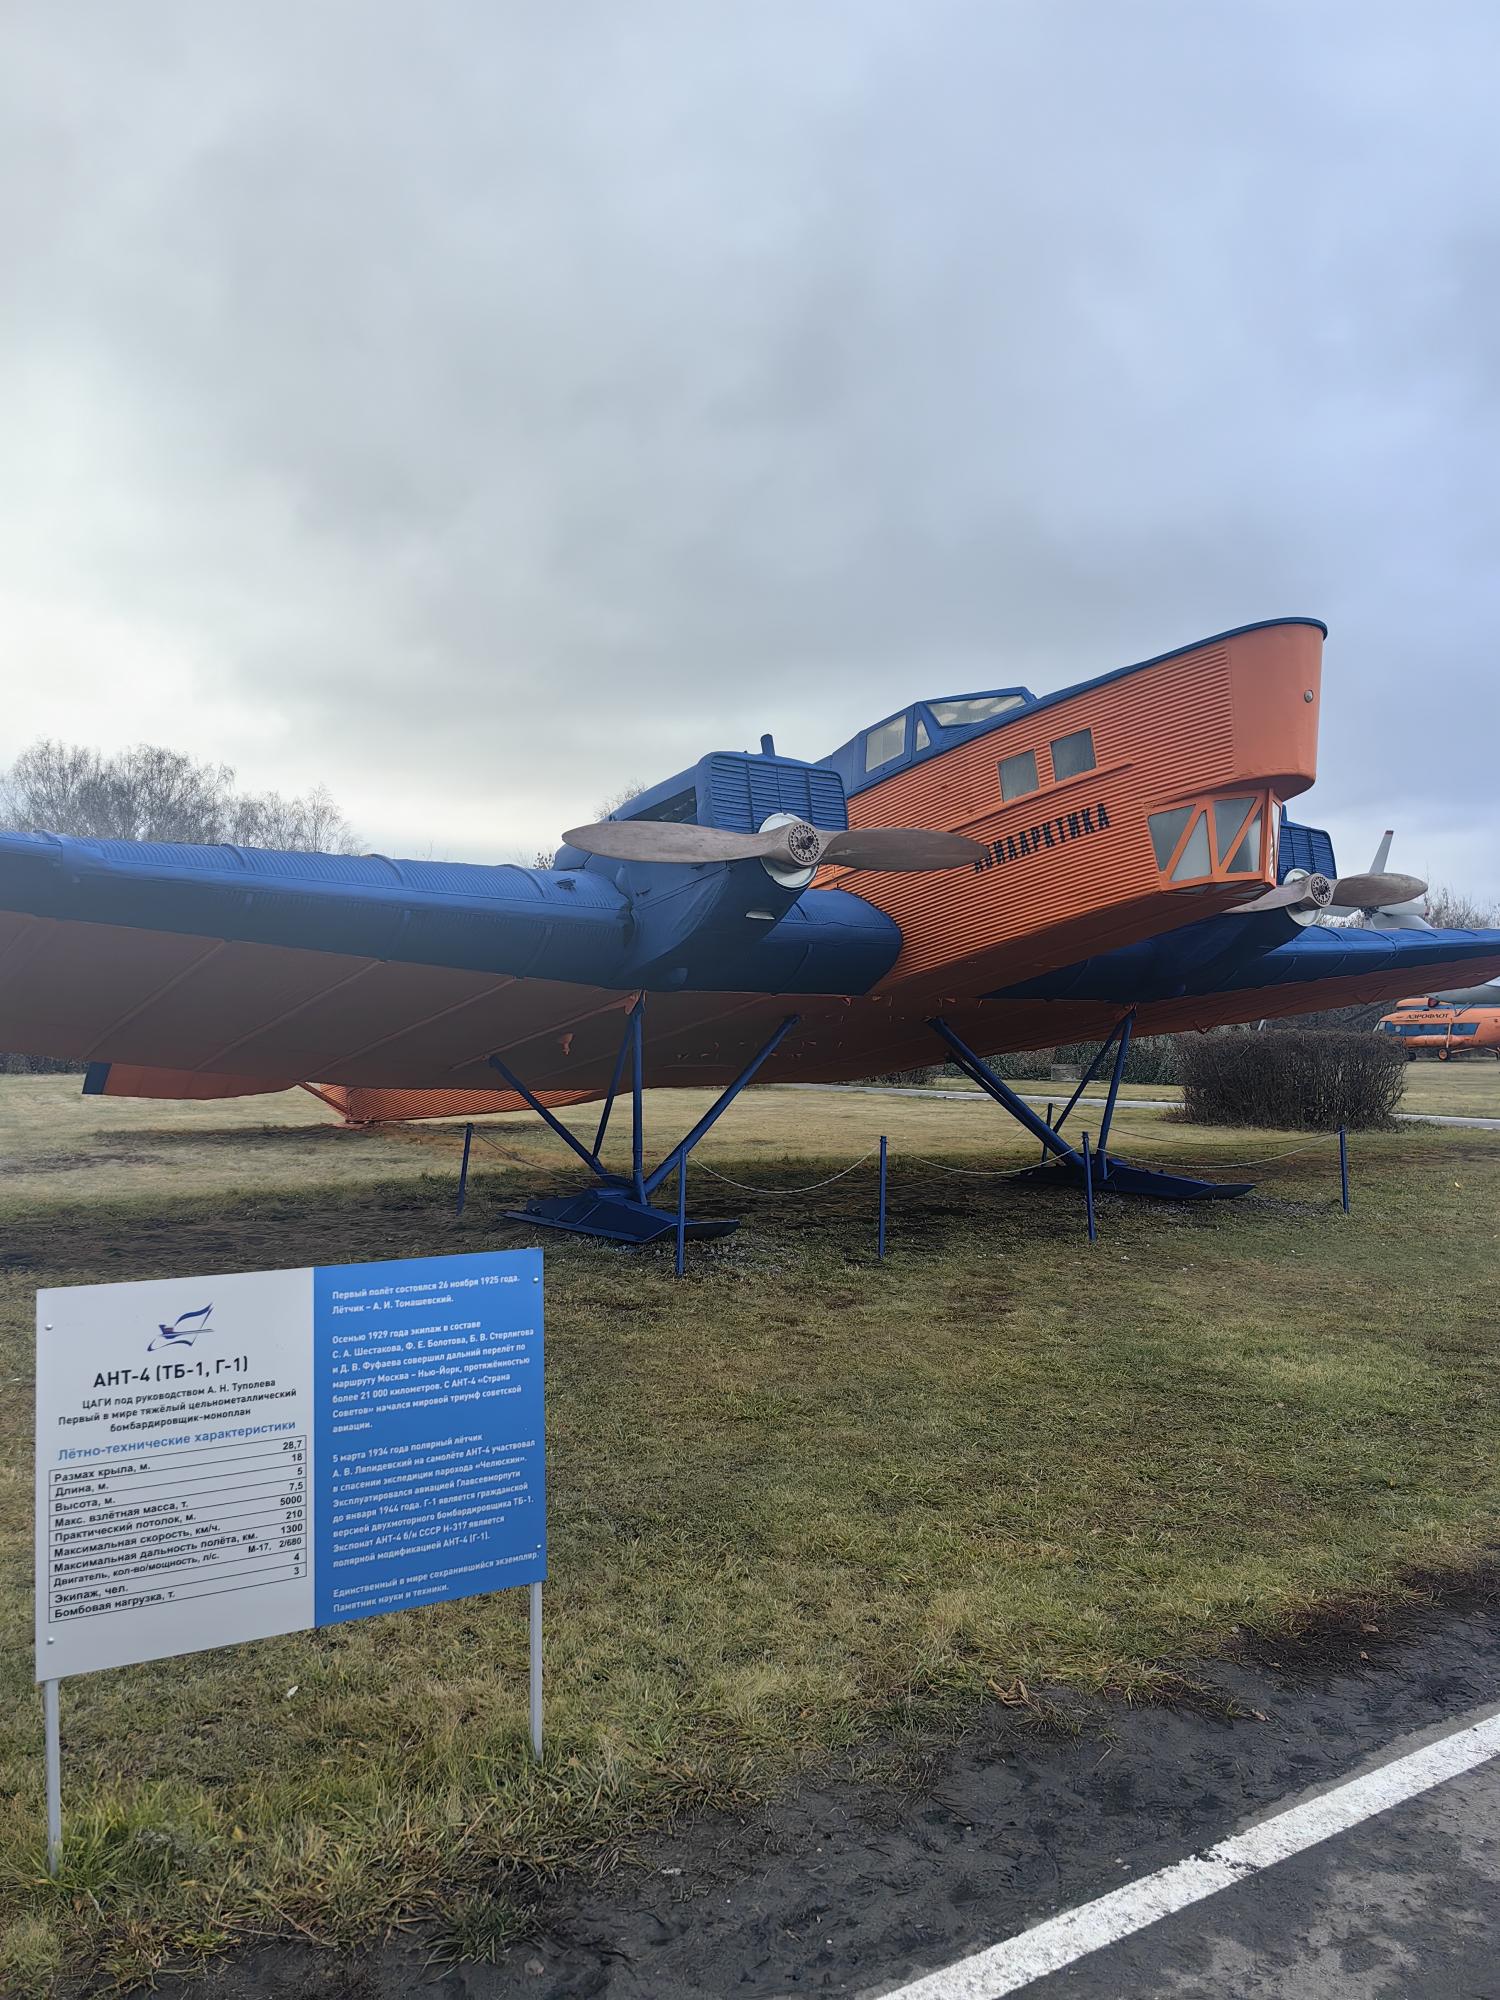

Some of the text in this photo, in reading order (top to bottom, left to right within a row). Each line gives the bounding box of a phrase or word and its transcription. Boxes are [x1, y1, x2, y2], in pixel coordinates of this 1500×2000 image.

[332, 1275, 520, 1300] Первый полёт состоялся 26 ноября 1925 года.
[332, 1305, 364, 1314] Лётчик
[373, 1302, 382, 1310] А.
[383, 1301, 393, 1309] И.
[395, 1294, 454, 1308] Томашевский.
[332, 1334, 366, 1344] Осенью
[368, 1330, 388, 1340] 1929
[389, 1329, 409, 1338] года
[410, 1326, 442, 1335] экипаж
[450, 1321, 481, 1331] составе
[332, 1329, 534, 1359] С. А. Шестакова, Ф. Е. Болотова, Б. В. Стерлигова
[93, 1355, 248, 1388] АНТ-4 (ТБ-1, Г-1)
[340, 1364, 350, 1374] Д.
[351, 1363, 360, 1371] В.
[362, 1359, 402, 1370] Фуфаева
[403, 1354, 445, 1365] совершил
[446, 1348, 481, 1360] дальний
[482, 1344, 515, 1356] перелёт
[332, 1377, 376, 1389] маршруту
[377, 1373, 409, 1383] Москва
[418, 1365, 462, 1378] Нью-Йорк,
[464, 1357, 530, 1372] протяжённостью
[82, 1380, 276, 1410] ЦАГИ под руководством А. Н. Туполева
[332, 1394, 359, 1403] более
[360, 1391, 370, 1400] 21
[372, 1388, 388, 1398] 000
[389, 1384, 442, 1396] километров.
[444, 1380, 450, 1389] С
[451, 1377, 476, 1388] АНТ-4
[376, 1402, 411, 1412] начался
[412, 1395, 449, 1407] мировой
[450, 1391, 481, 1403] триумф
[482, 1384, 522, 1397] советской
[58, 1412, 100, 1426] Первый
[111, 1410, 138, 1419] мире
[140, 1402, 186, 1415] тяжёлый
[188, 1388, 296, 1410] цельнометаллический
[110, 1409, 251, 1432] бомбардировщик-моноплан
[332, 1422, 373, 1433] авиации.
[58, 1421, 296, 1461] Лётно-технические характеристики
[282, 1440, 302, 1451] 28,7
[333, 1434, 483, 1463] 5 марта 1934 года полярный лётчик
[292, 1453, 302, 1462] 18
[332, 1469, 341, 1478] А.
[344, 1468, 353, 1476] В.
[354, 1458, 412, 1474] Ляпидевский
[426, 1451, 464, 1463] самолёте
[465, 1446, 490, 1457] АНТ-4
[492, 1440, 535, 1454] участвовал
[55, 1471, 94, 1482] Размах
[98, 1466, 136, 1478] крыла,
[297, 1467, 303, 1476] 5
[340, 1479, 381, 1491] спасении
[383, 1471, 433, 1485] экспедиции
[435, 1464, 473, 1476] парохода
[55, 1485, 94, 1497] Длина,
[289, 1481, 303, 1491] 7,5
[333, 1471, 520, 1508] Эксплуатировался авиацией Главсевморпути
[55, 1499, 101, 1512] Высота,
[280, 1495, 302, 1506] 5000
[332, 1482, 528, 1524] до января 1944 года. Г-1 является гражданской
[55, 1517, 85, 1526] Макс.
[89, 1508, 140, 1522] взлётная
[143, 1503, 178, 1514] масса,
[286, 1509, 302, 1520] 210
[333, 1495, 534, 1538] версией двухмоторного бомбардировщика ТБ-1.
[55, 1522, 132, 1542] Практический
[136, 1516, 182, 1529] потолок,
[55, 1524, 220, 1557] Максимальная скорость, км/ч.
[281, 1523, 303, 1534] 1300
[333, 1539, 373, 1553] Экспонат
[375, 1533, 401, 1545] АНТ-4
[419, 1526, 442, 1537] СССР
[443, 1521, 467, 1533] Н-317
[468, 1516, 505, 1528] является
[55, 1533, 258, 1572] Максимальная дальность полёта, км.
[248, 1537, 301, 1553] М-17, 2/680
[293, 1552, 300, 1561] 4
[333, 1553, 375, 1568] полярной
[377, 1540, 441, 1560] модификацией
[443, 1536, 468, 1548] АНТ-4
[54, 1553, 219, 1587] Двигатель, кол-во/мощность, л/с.
[294, 1566, 299, 1575] 3
[333, 1578, 398, 1598] Единственный
[406, 1574, 428, 1584] мире
[429, 1561, 494, 1579] сохранившийся
[496, 1552, 539, 1566] экземпляр.
[55, 1585, 128, 1603] Экипаж, чел.
[55, 1602, 111, 1618] Бомбовая
[115, 1593, 164, 1607] нагрузка,
[333, 1598, 376, 1613] Памятник
[378, 1593, 404, 1604] науки
[412, 1584, 449, 1597] техники.
